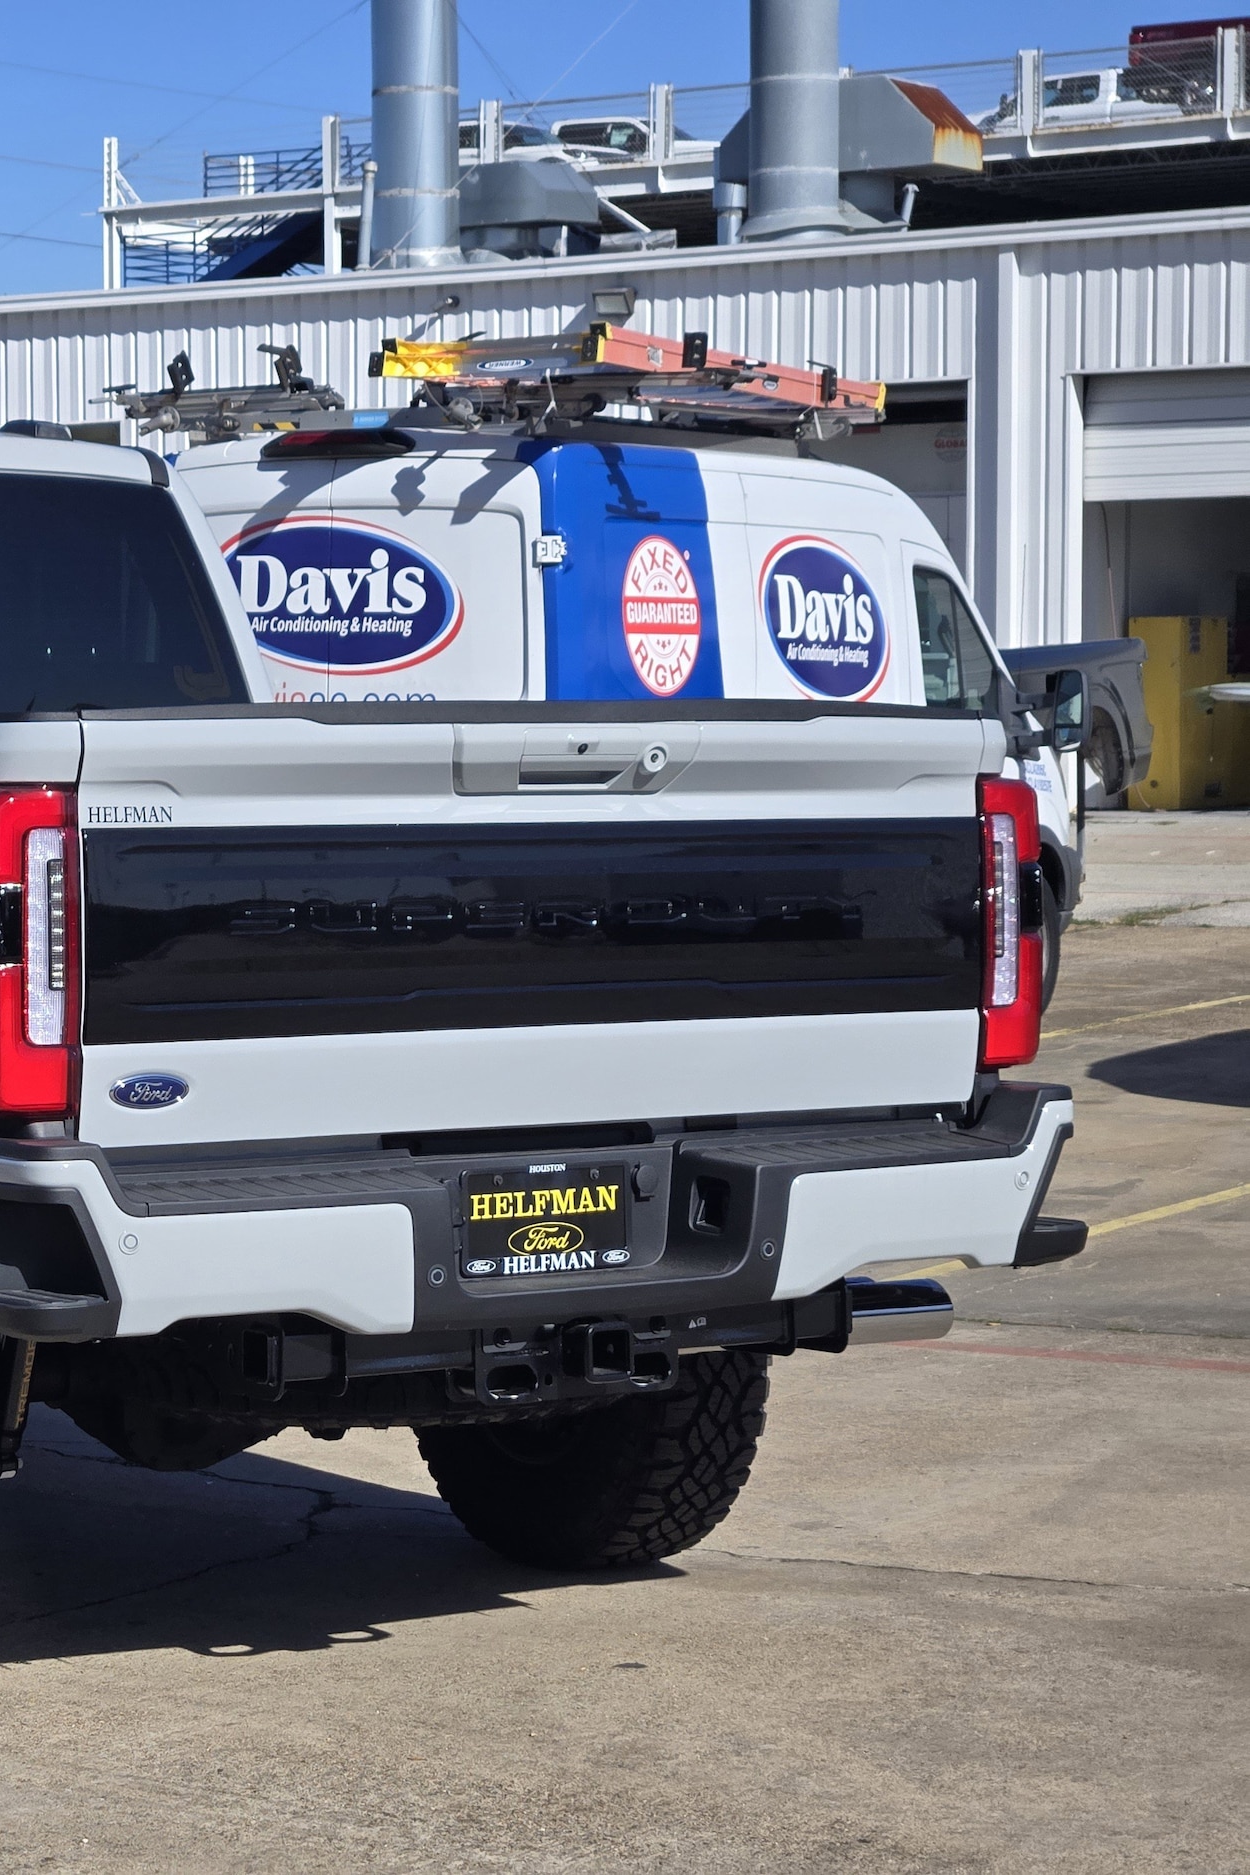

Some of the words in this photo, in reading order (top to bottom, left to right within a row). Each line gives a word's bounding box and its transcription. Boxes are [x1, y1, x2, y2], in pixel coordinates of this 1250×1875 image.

[934, 439, 967, 448] GLOBA
[236, 548, 427, 614] Davis
[631, 546, 688, 594] FIXED
[626, 602, 697, 625] GUARANTEED
[773, 573, 874, 645] Davis
[251, 617, 267, 632] Air
[270, 617, 349, 637] Conditioning
[350, 617, 360, 632] &
[362, 617, 413, 637] Heating
[634, 640, 691, 687] RIGHT
[786, 642, 797, 660] Air
[798, 643, 839, 667] Conditioning
[838, 645, 844, 662] &
[844, 646, 869, 668] Heating
[88, 806, 173, 823] HELFMAN
[129, 1082, 173, 1102] Ford
[529, 1163, 566, 1173] HOUSTON
[470, 1185, 619, 1220] HELFMAN
[523, 1226, 571, 1252] Ford
[502, 1250, 597, 1275] HELFMAN
